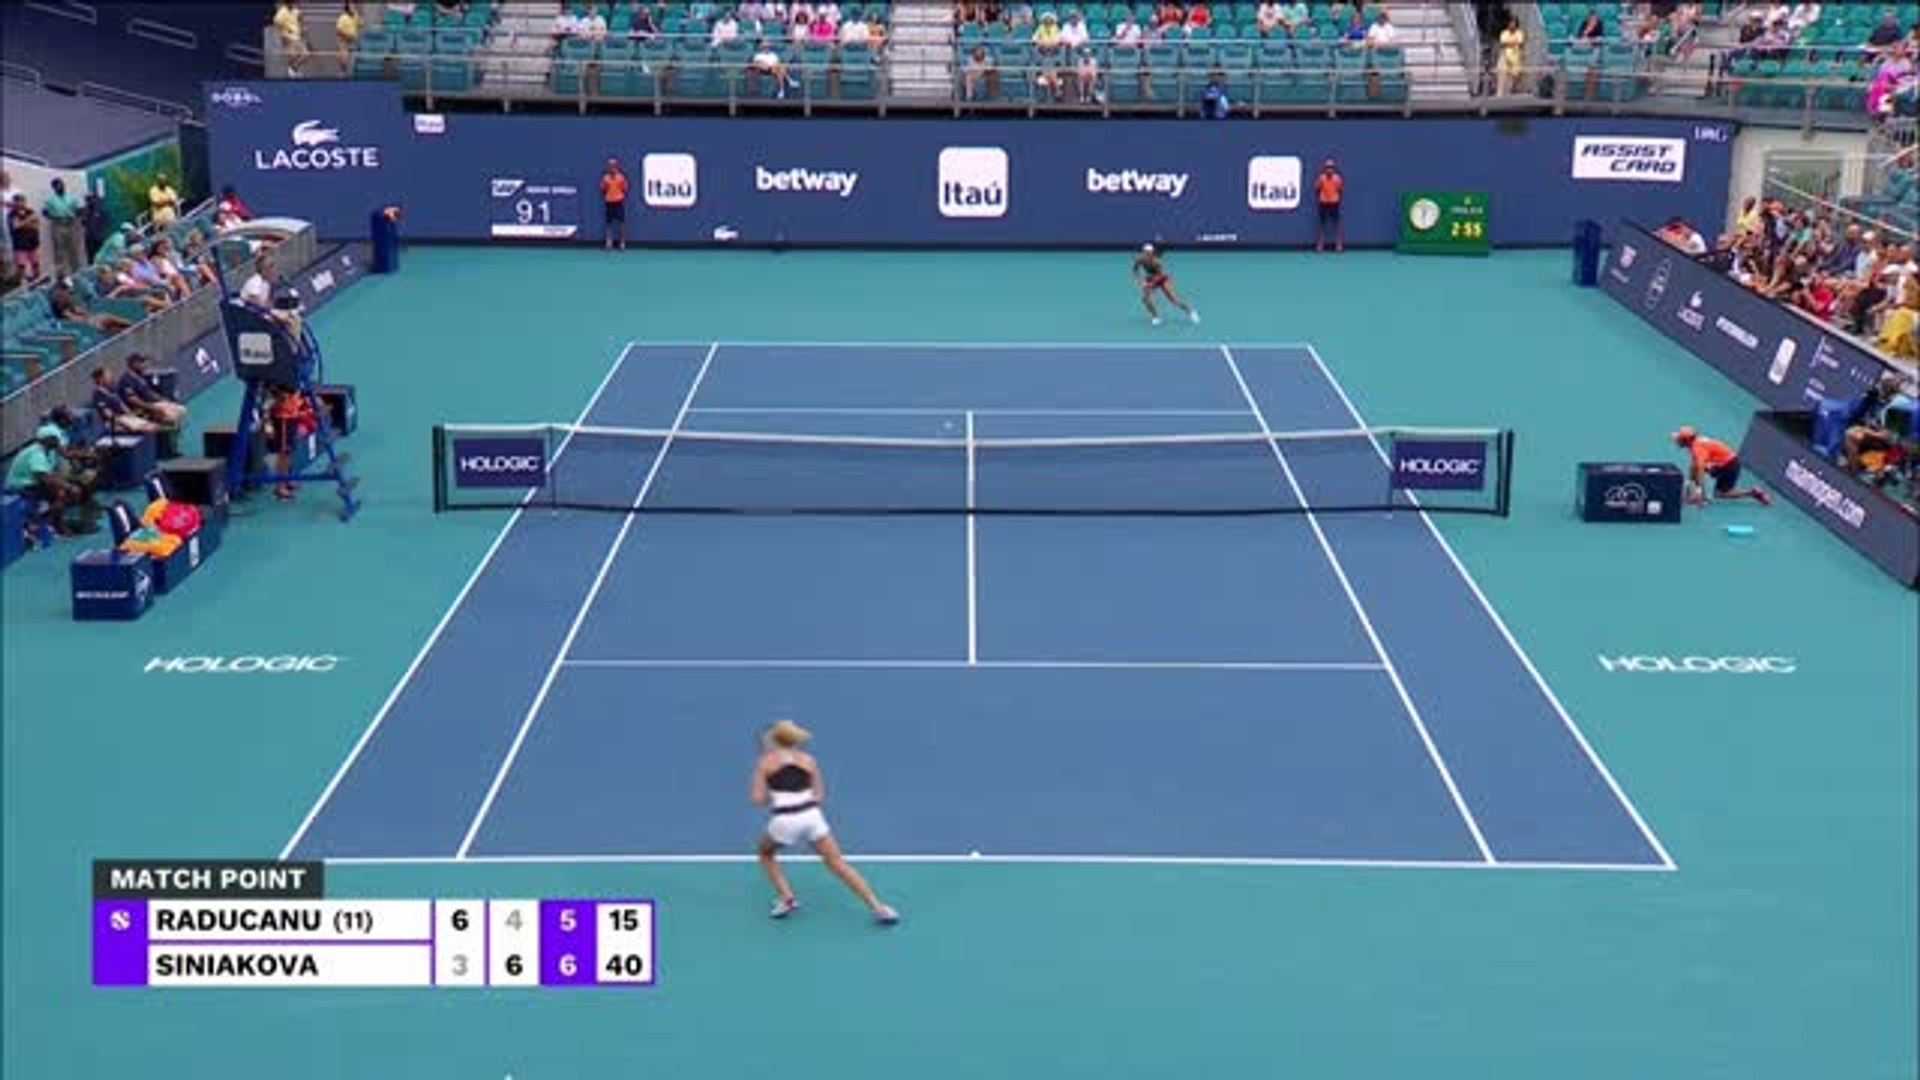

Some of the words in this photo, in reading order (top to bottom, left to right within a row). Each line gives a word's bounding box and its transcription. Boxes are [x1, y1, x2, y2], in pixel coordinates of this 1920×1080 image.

[255, 147, 380, 170] LACOSTE
[1582, 143, 1674, 159] ASSIST
[1610, 160, 1678, 174] CARD
[647, 178, 692, 199] Itaú
[756, 166, 858, 198] betway
[1087, 167, 1189, 198] betway
[1251, 181, 1297, 201] Itaú
[944, 182, 1003, 208] Itaú
[515, 199, 551, 224] 91
[460, 455, 540, 473] HOLOGIC
[1400, 458, 1480, 475] HOLOGIC
[144, 655, 341, 674] HOLOGIC
[1598, 655, 1798, 674] HOLOGIC
